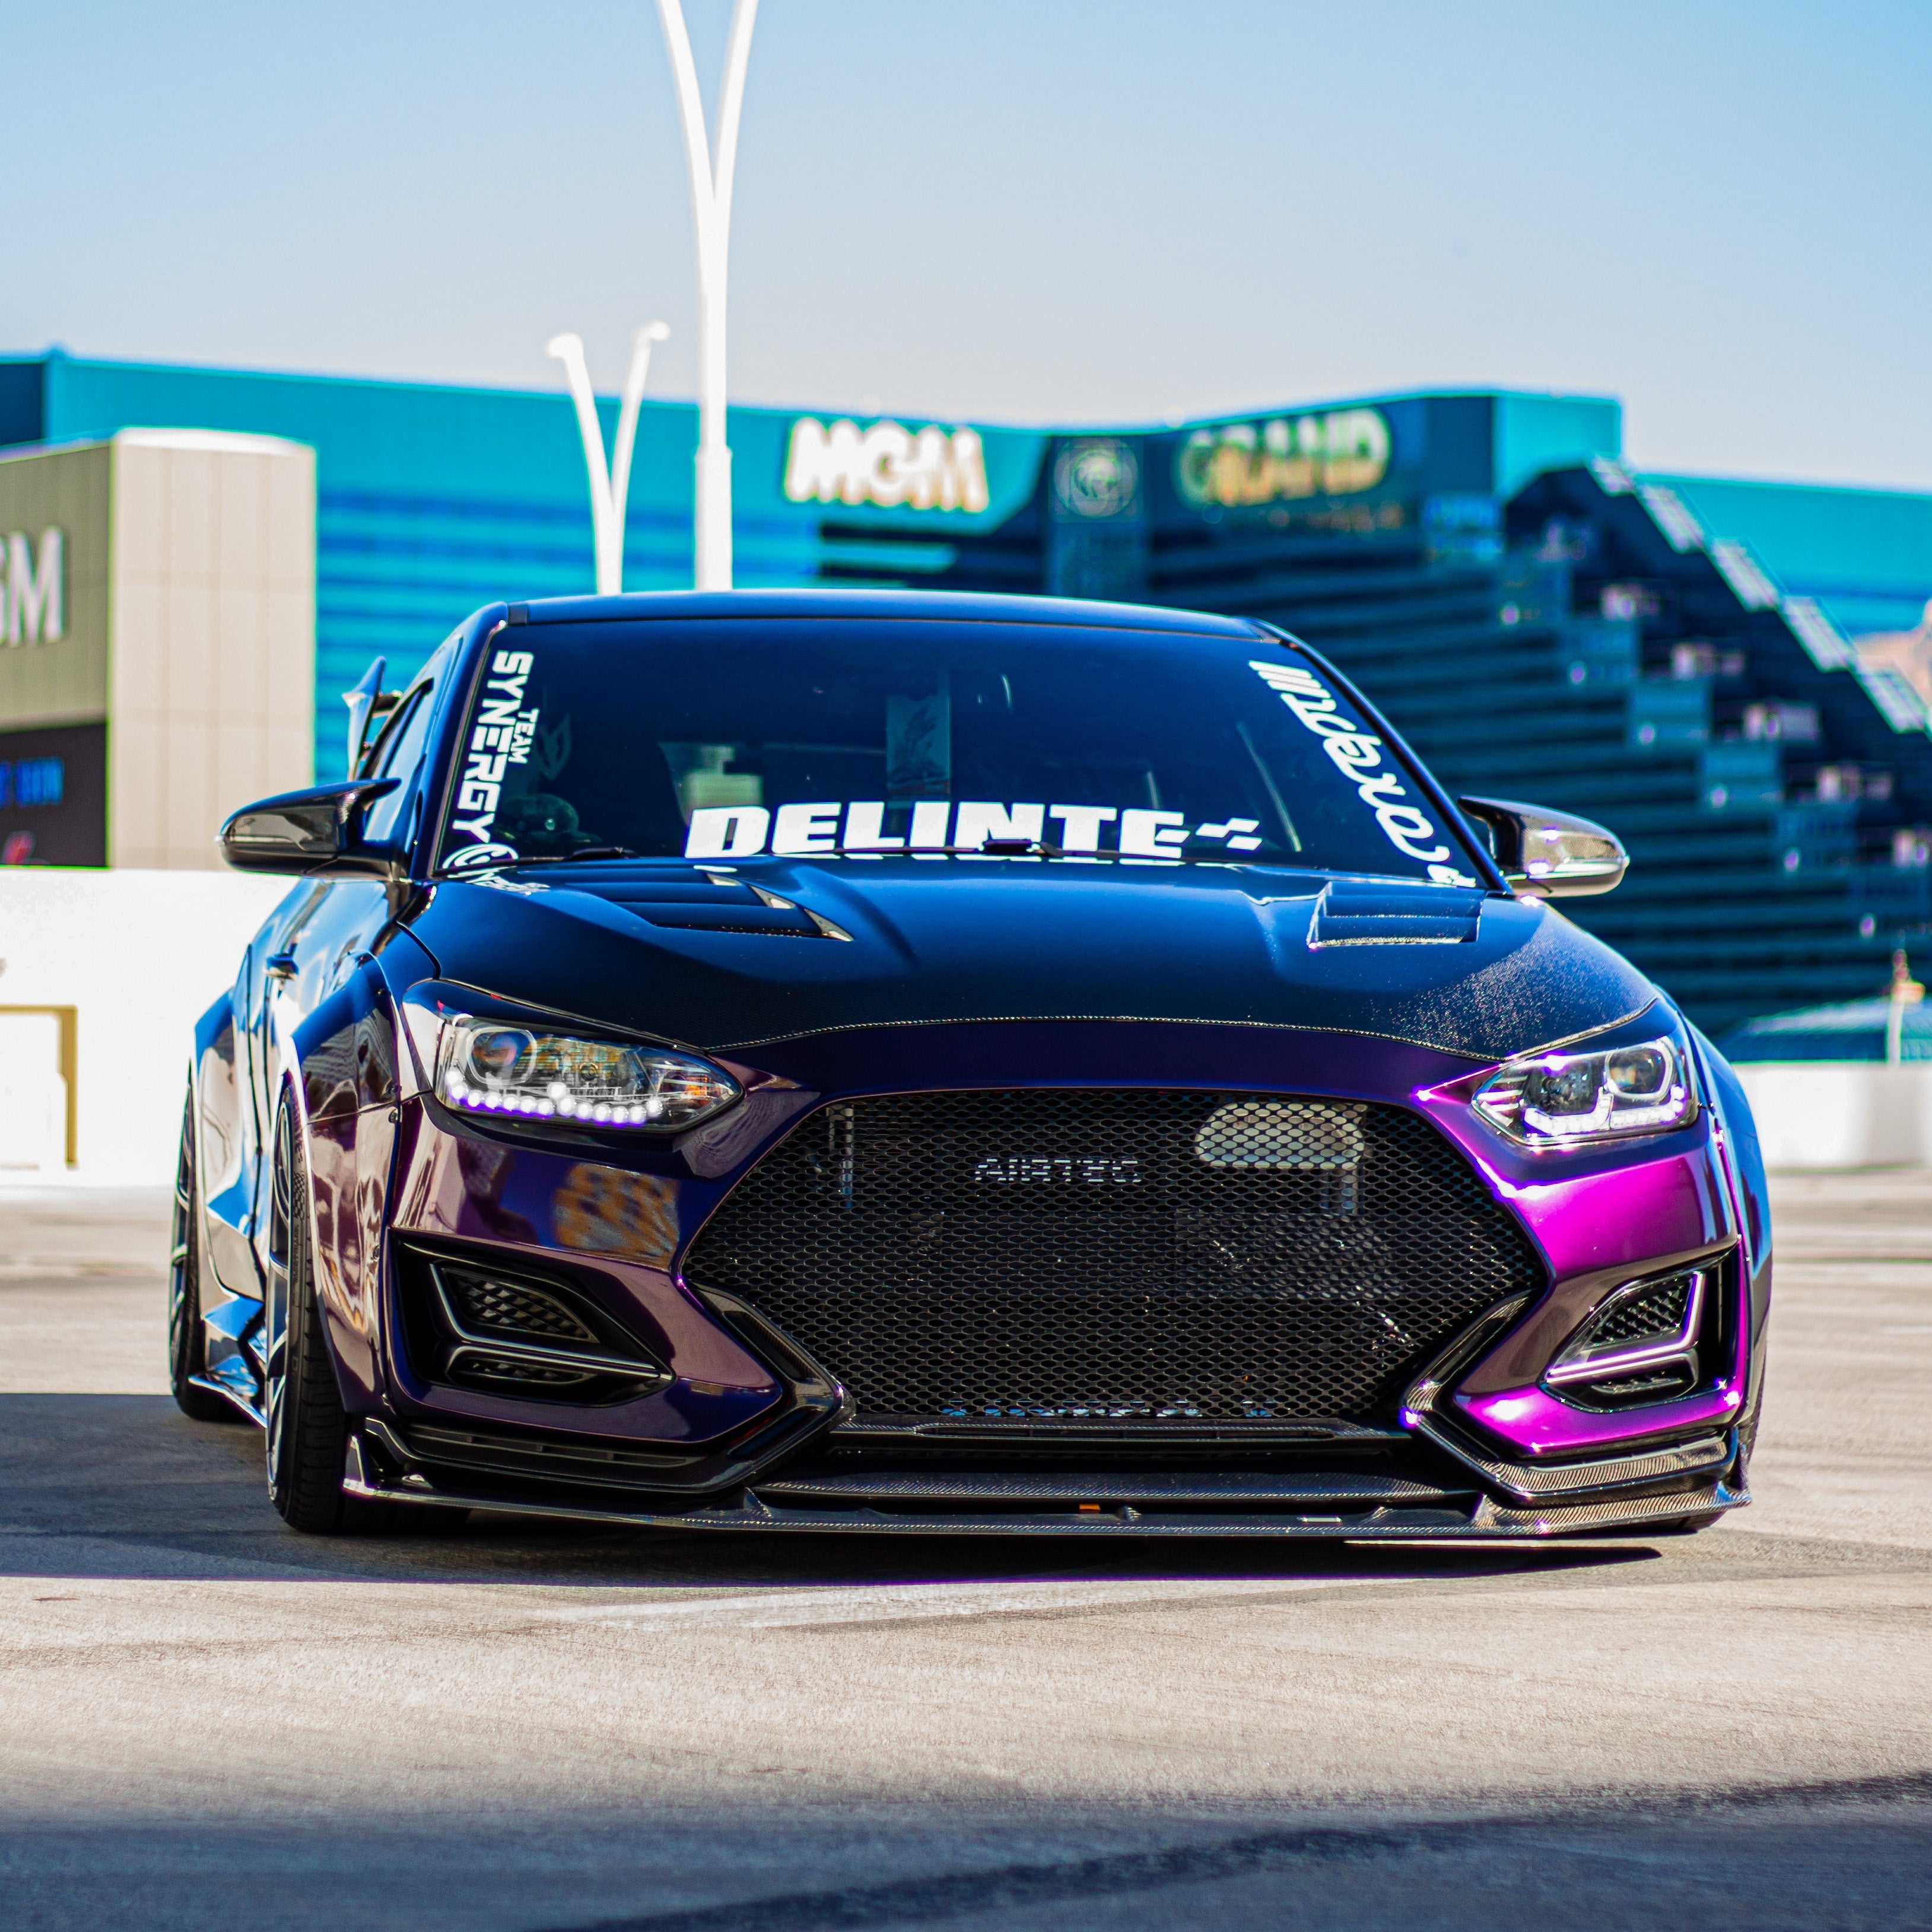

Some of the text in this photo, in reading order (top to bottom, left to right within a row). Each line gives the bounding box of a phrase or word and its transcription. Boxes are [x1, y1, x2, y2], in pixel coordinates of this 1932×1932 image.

[786, 417, 989, 513] MGM
[452, 650, 534, 843] SYNERGY
[508, 708, 539, 764] TEAM
[685, 802, 1190, 858] DELINTE
